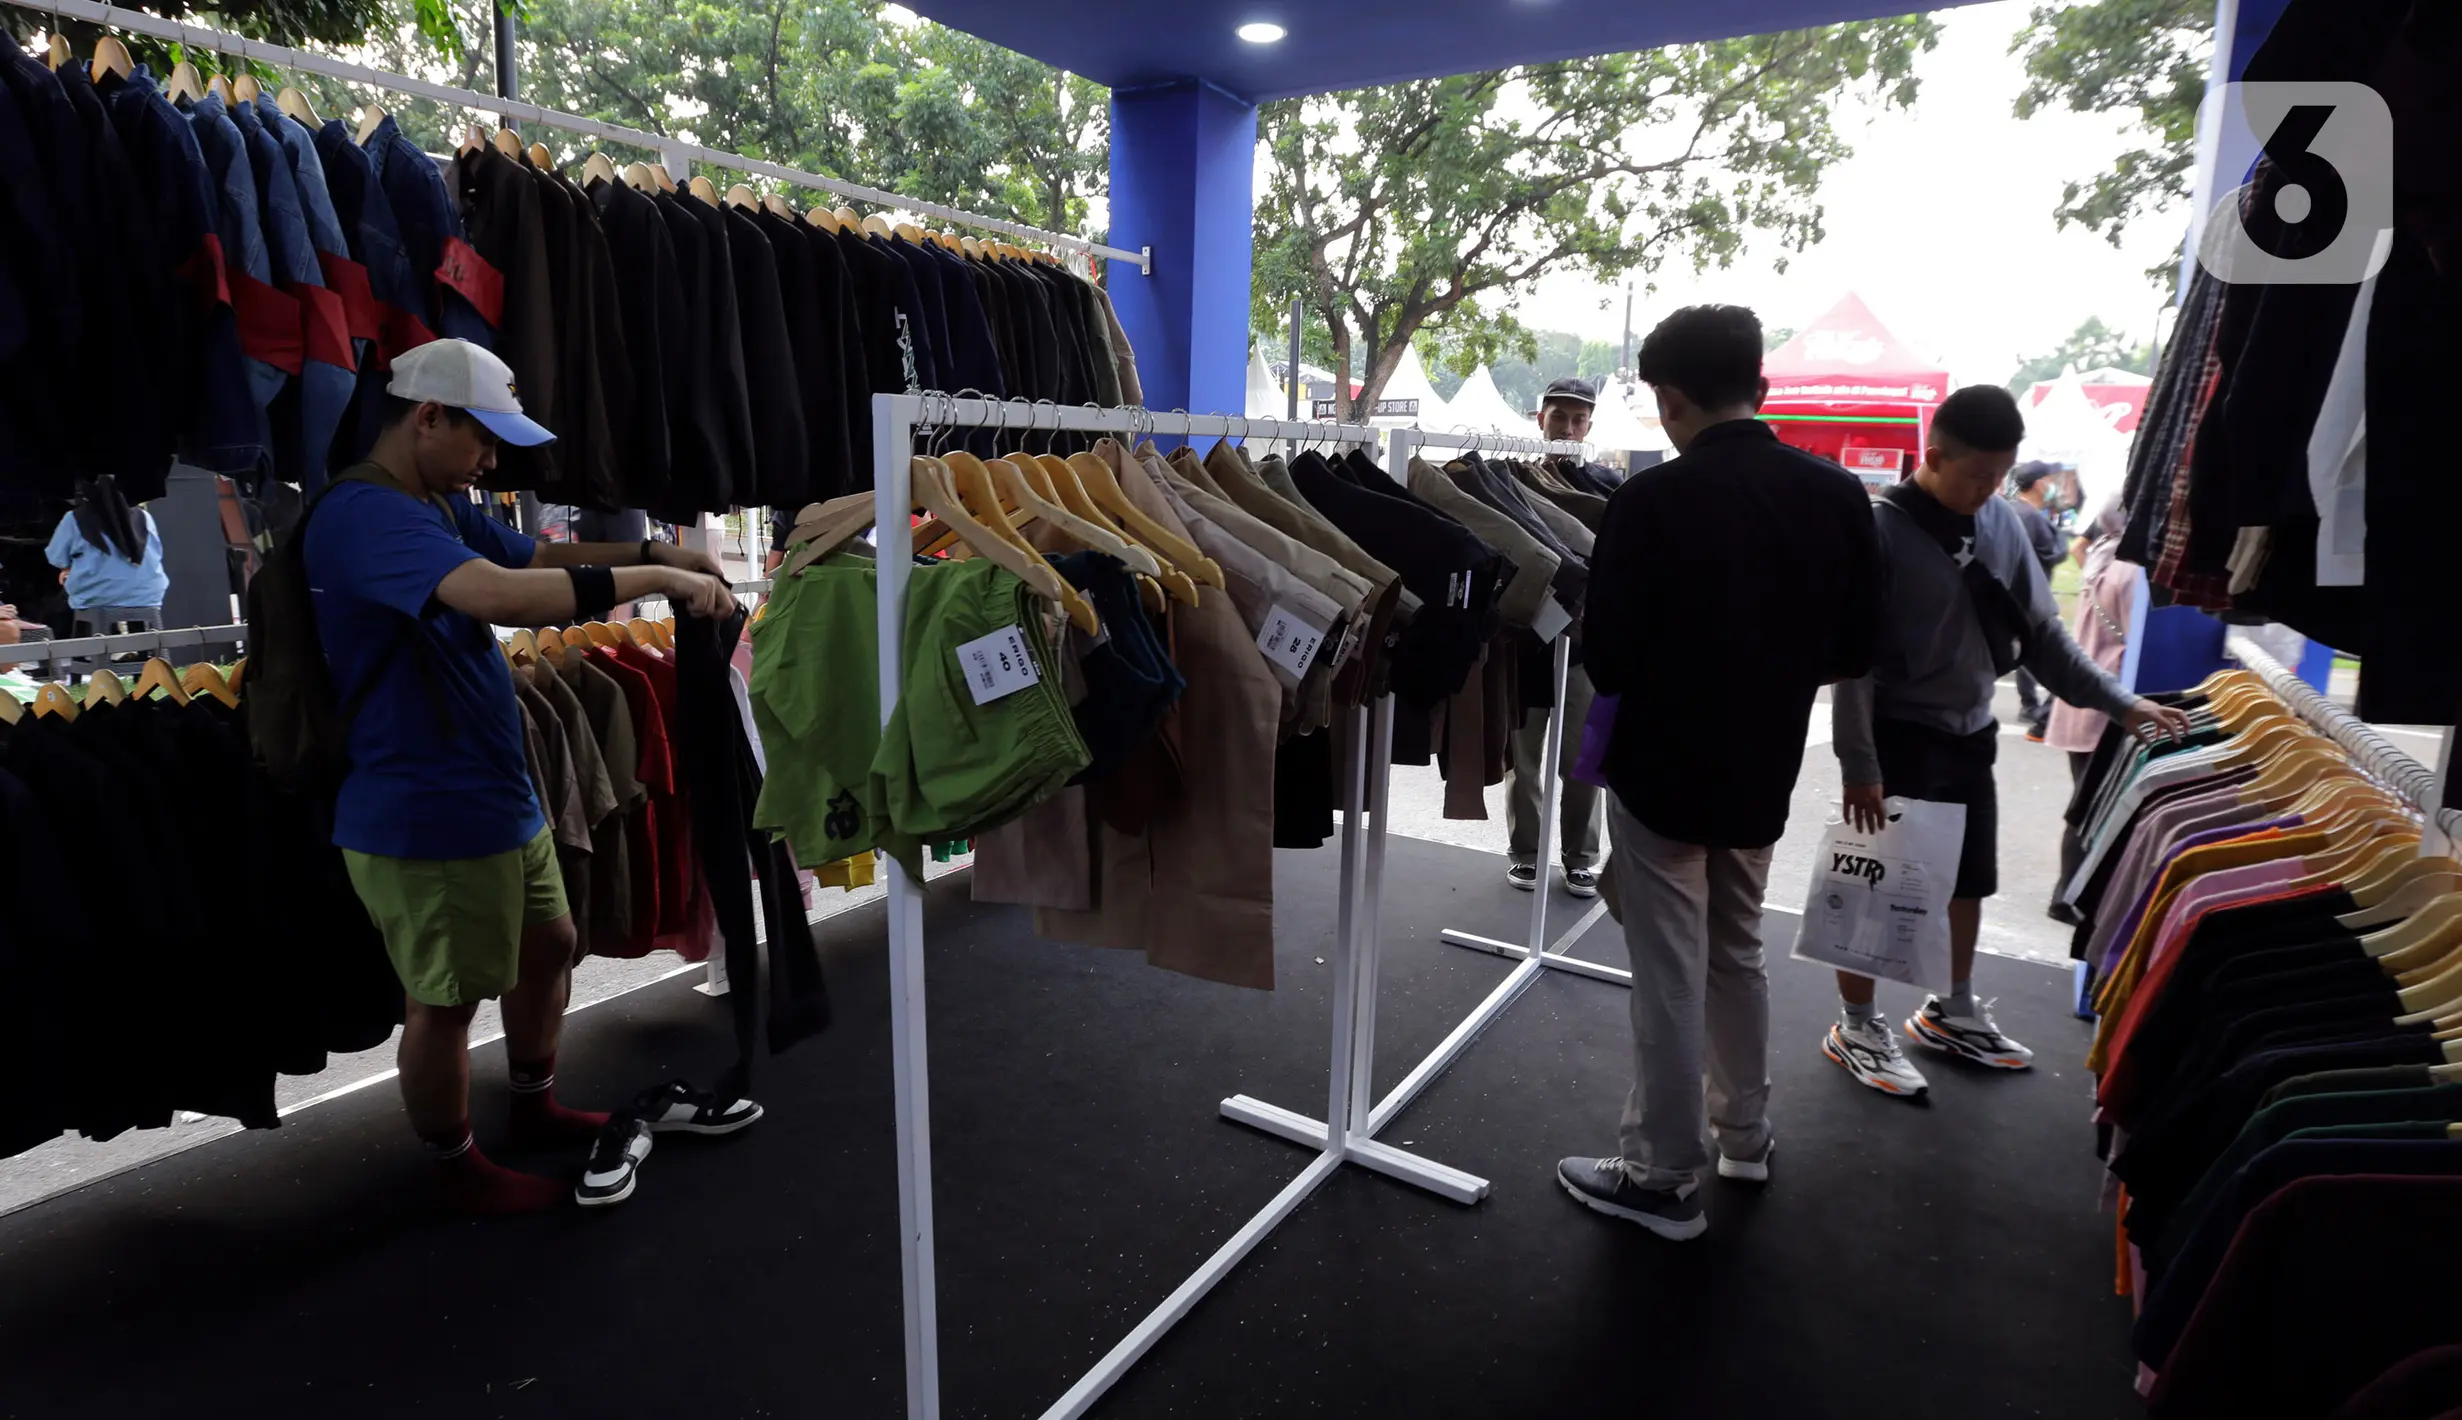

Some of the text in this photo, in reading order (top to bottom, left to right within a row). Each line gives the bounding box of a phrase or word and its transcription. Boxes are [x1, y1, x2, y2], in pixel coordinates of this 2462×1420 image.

[1387, 401, 1408, 413] STORE
[1008, 635, 1029, 676] ERIGO
[1290, 637, 1301, 654] 28
[1297, 637, 1316, 669] ERIGO
[999, 652, 1011, 672] 40
